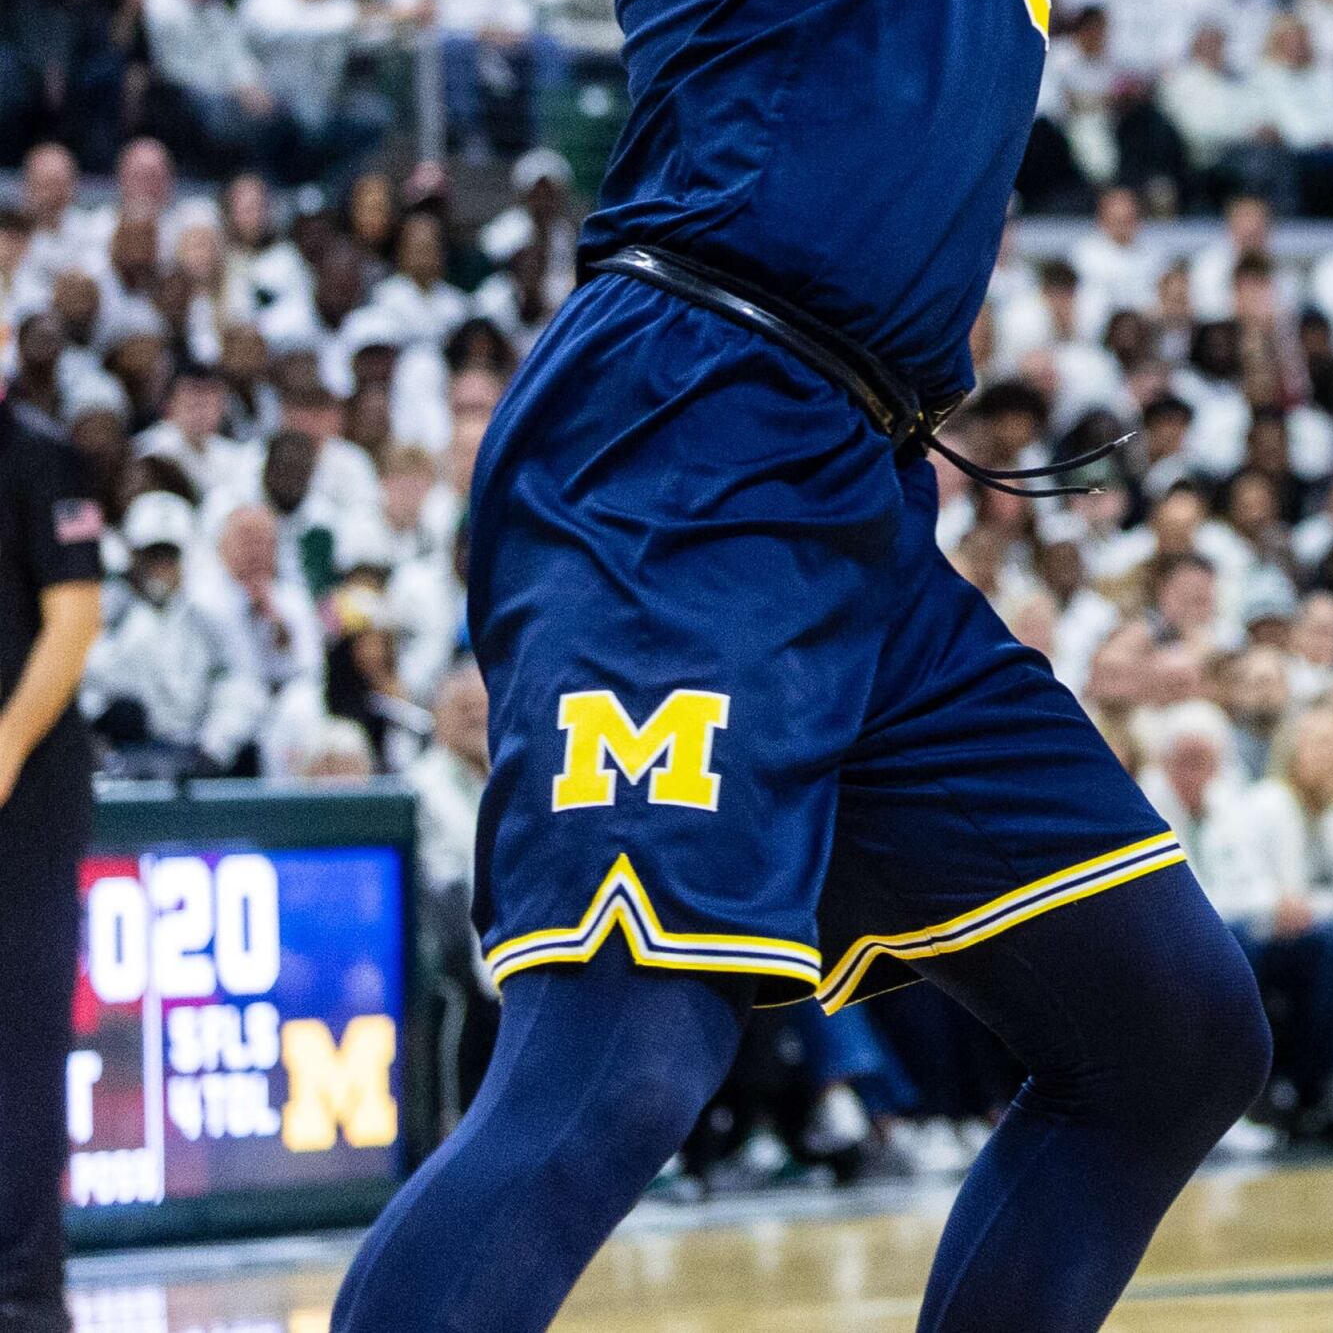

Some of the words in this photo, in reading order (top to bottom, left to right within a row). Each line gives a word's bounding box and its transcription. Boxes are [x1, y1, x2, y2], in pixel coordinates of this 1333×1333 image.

[552, 688, 731, 813] M
[147, 852, 281, 999] 20
[280, 1013, 398, 1153] M
